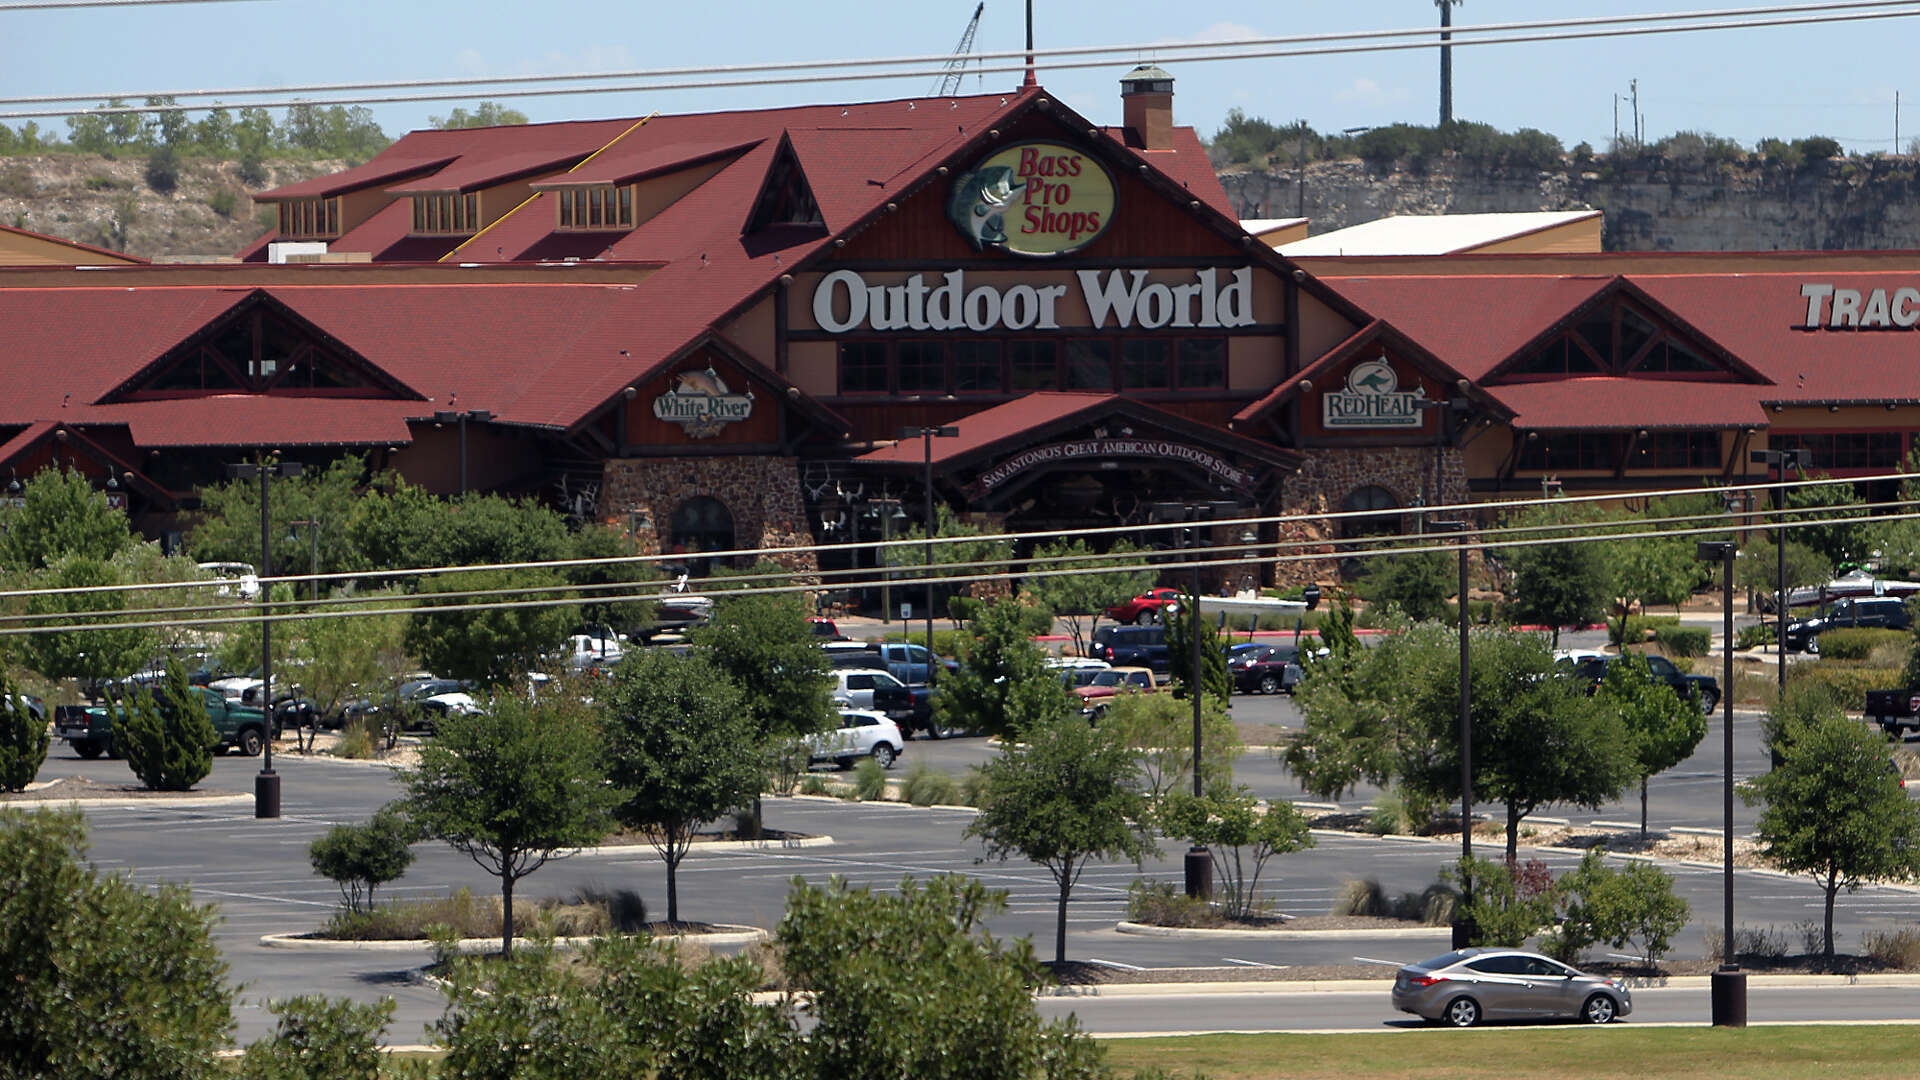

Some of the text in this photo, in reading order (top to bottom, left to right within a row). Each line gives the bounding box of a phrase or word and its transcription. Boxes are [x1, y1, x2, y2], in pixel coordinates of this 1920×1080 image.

[1018, 148, 1082, 177] Bass
[1023, 177, 1071, 206] Pro
[1021, 206, 1100, 241] Shops
[812, 266, 1257, 334] Outdoor World
[657, 396, 749, 417] White River
[982, 468, 1006, 488] SAN
[1064, 442, 1098, 457] GREAT
[1102, 442, 1157, 455] AMERICAN
[1158, 443, 1213, 467] OUTDOOR
[1212, 459, 1242, 484] STORE
